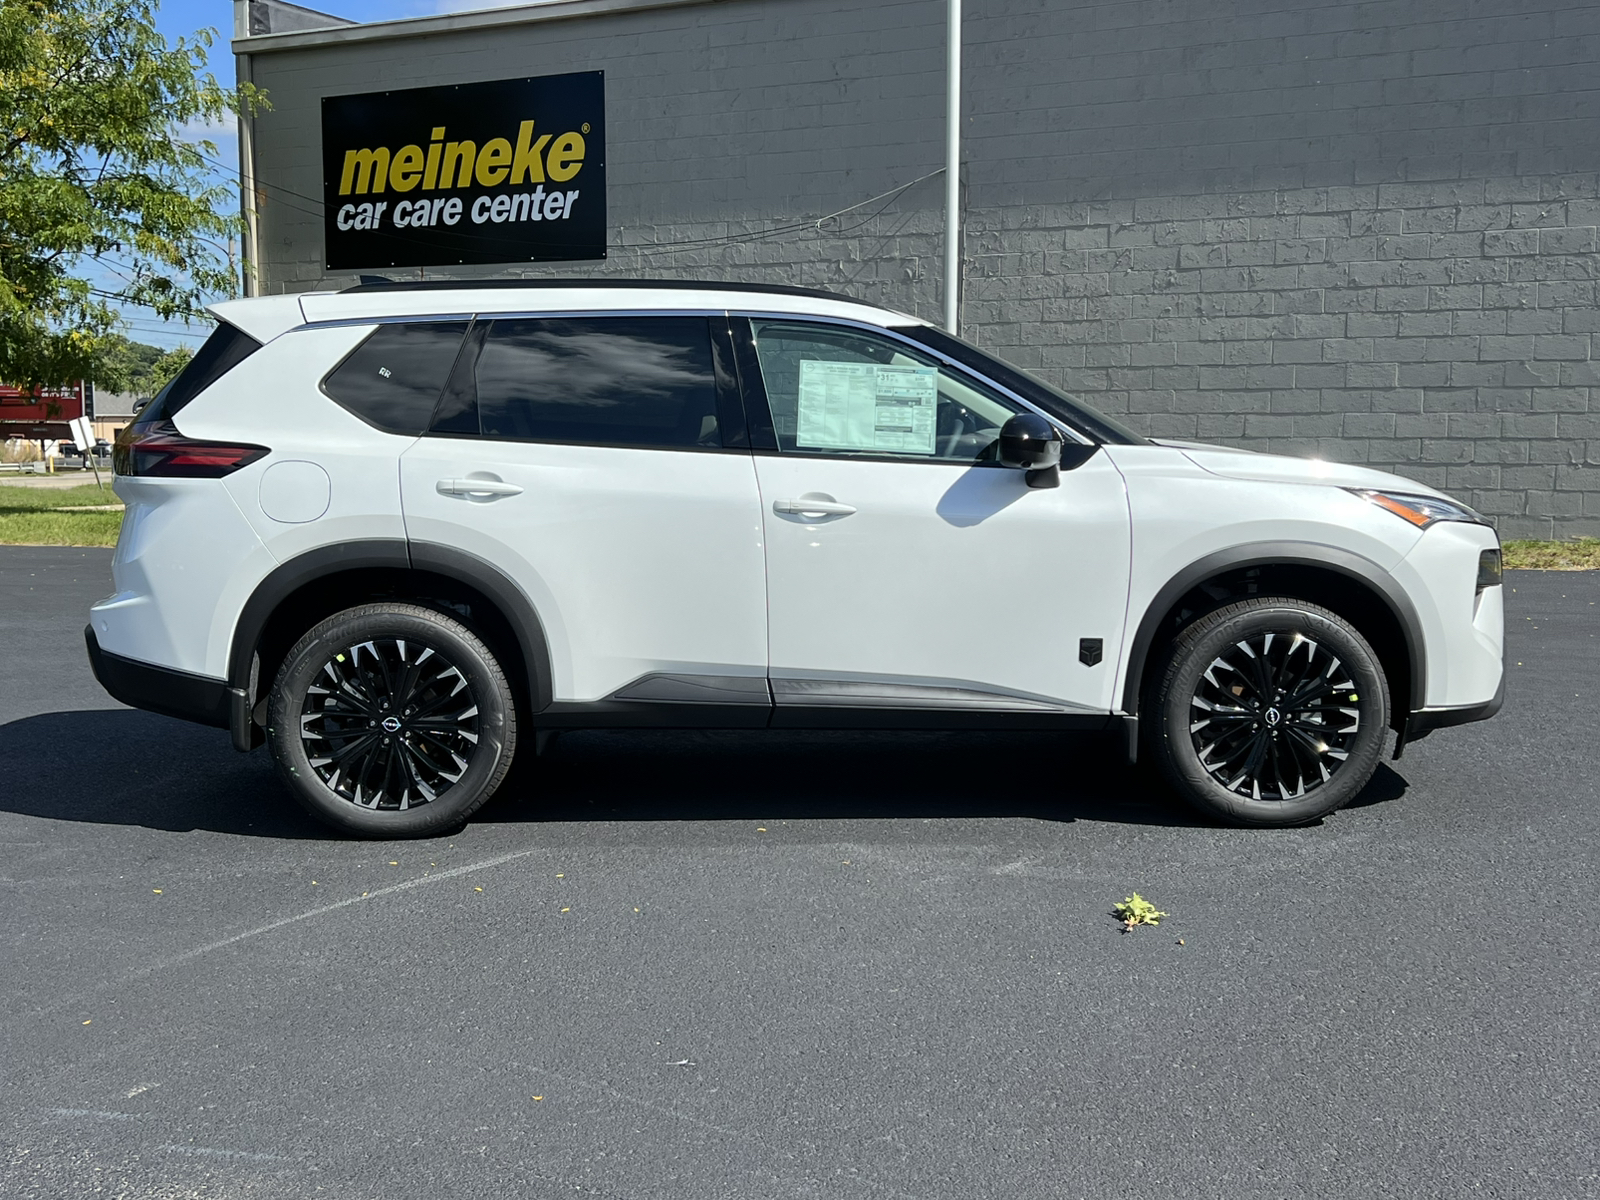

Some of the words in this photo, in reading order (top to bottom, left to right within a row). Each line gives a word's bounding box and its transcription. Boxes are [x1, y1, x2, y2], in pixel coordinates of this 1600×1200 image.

[337, 201, 388, 231] car
[393, 197, 463, 229] care
[471, 184, 580, 225] center
